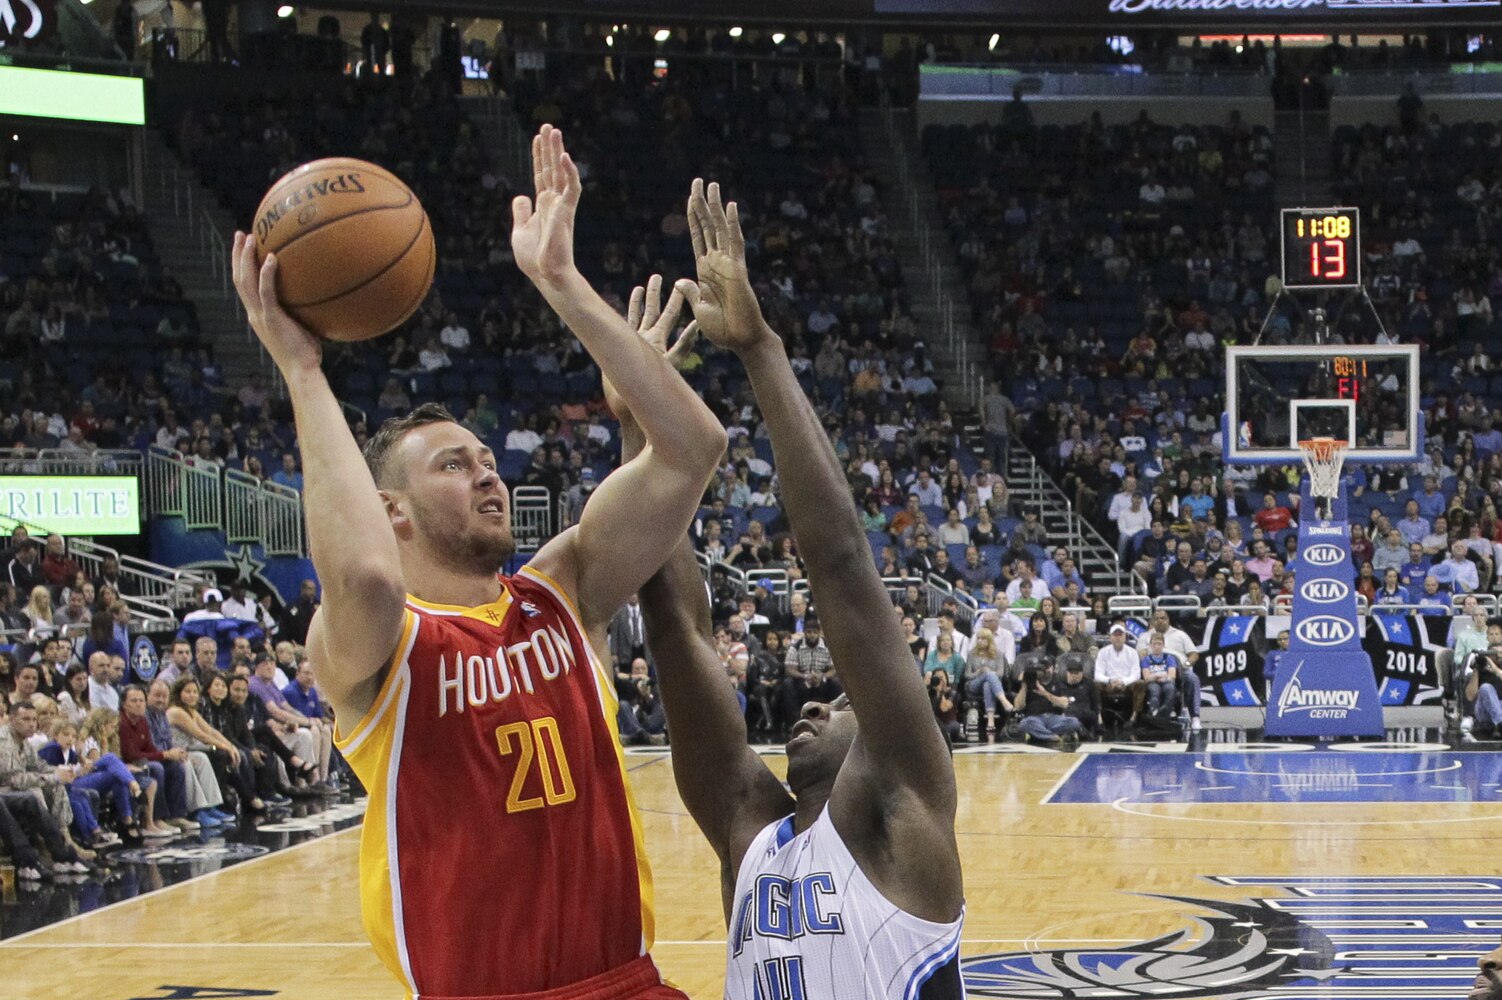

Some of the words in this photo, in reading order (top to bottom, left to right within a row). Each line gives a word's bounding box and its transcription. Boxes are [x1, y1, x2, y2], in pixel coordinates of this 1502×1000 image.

[1297, 216, 1351, 238] 11:08
[1311, 240, 1345, 278] 13
[1311, 548, 1338, 561] KIA
[1309, 584, 1341, 598] KIA
[1306, 622, 1345, 639] KIA
[438, 614, 577, 718] HOUTON
[1205, 650, 1247, 677] 1989
[1386, 649, 1428, 675] 2014
[1281, 675, 1361, 712] Amway
[1309, 709, 1348, 719] CENTER
[495, 716, 577, 814] 20
